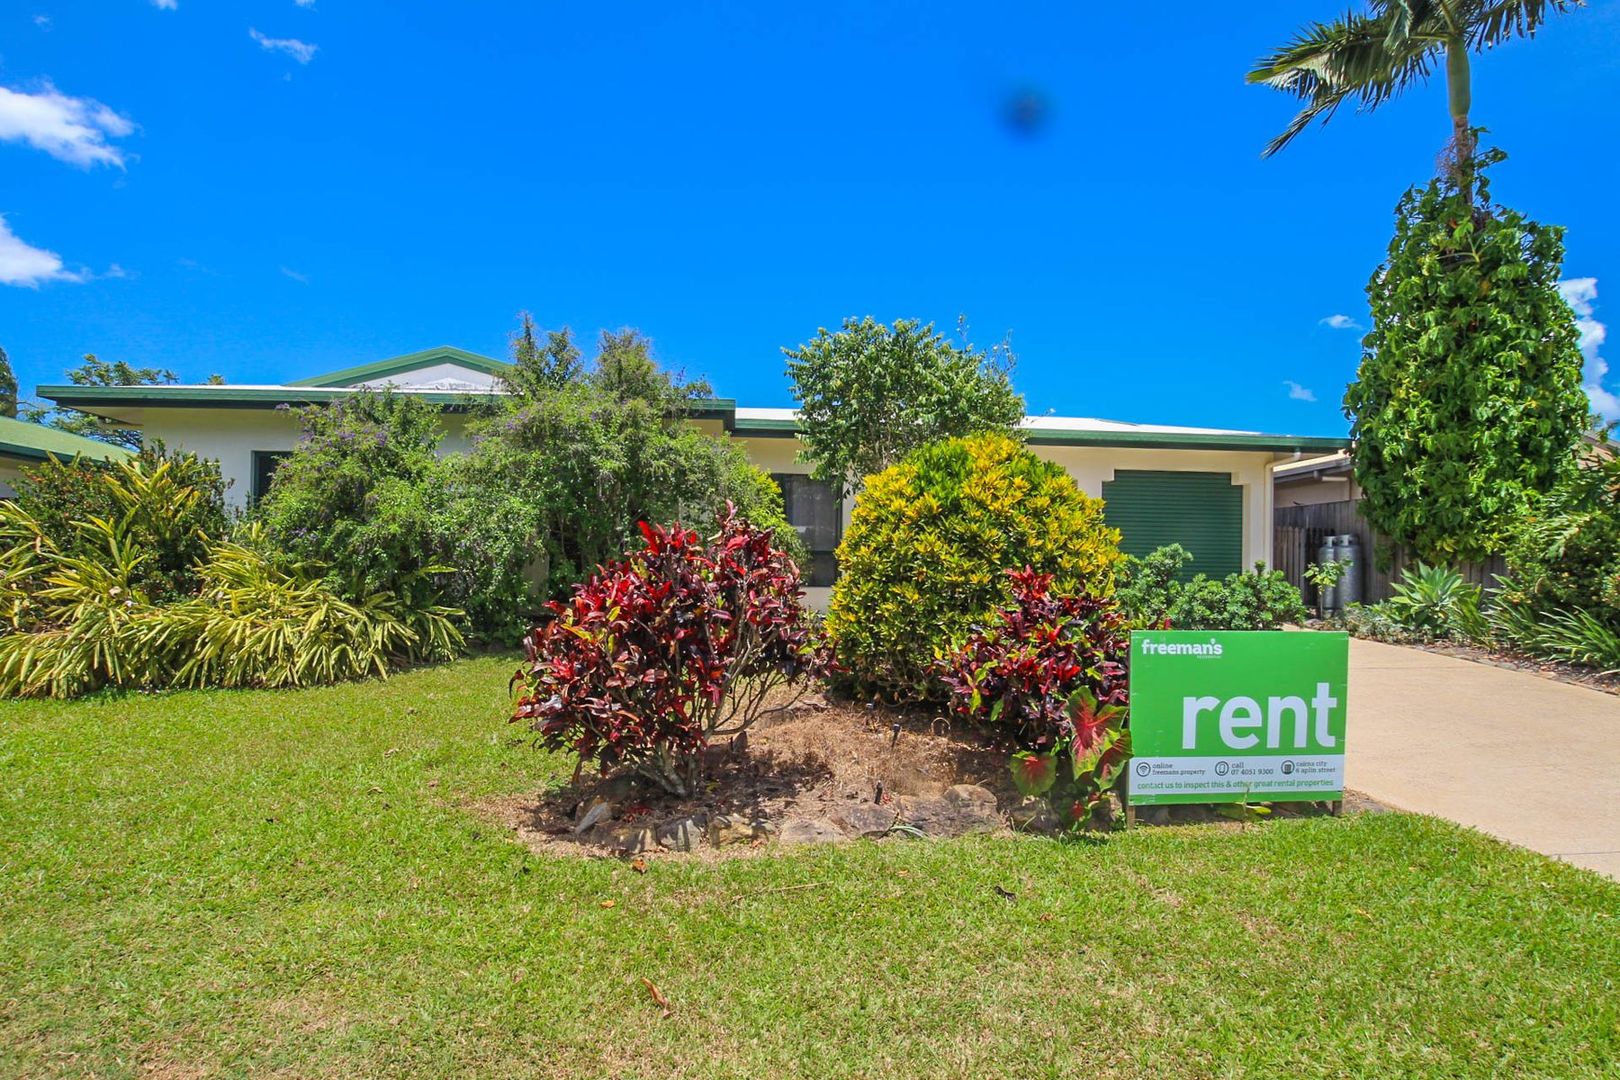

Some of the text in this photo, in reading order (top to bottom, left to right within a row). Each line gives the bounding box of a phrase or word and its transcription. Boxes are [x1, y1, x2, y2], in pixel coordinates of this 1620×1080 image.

[1182, 682, 1337, 750] rent
[1137, 782, 1164, 790] contact
[1184, 780, 1209, 789] inspect
[1211, 780, 1225, 788] this
[1253, 780, 1273, 788] great
[1296, 779, 1333, 788] properties
